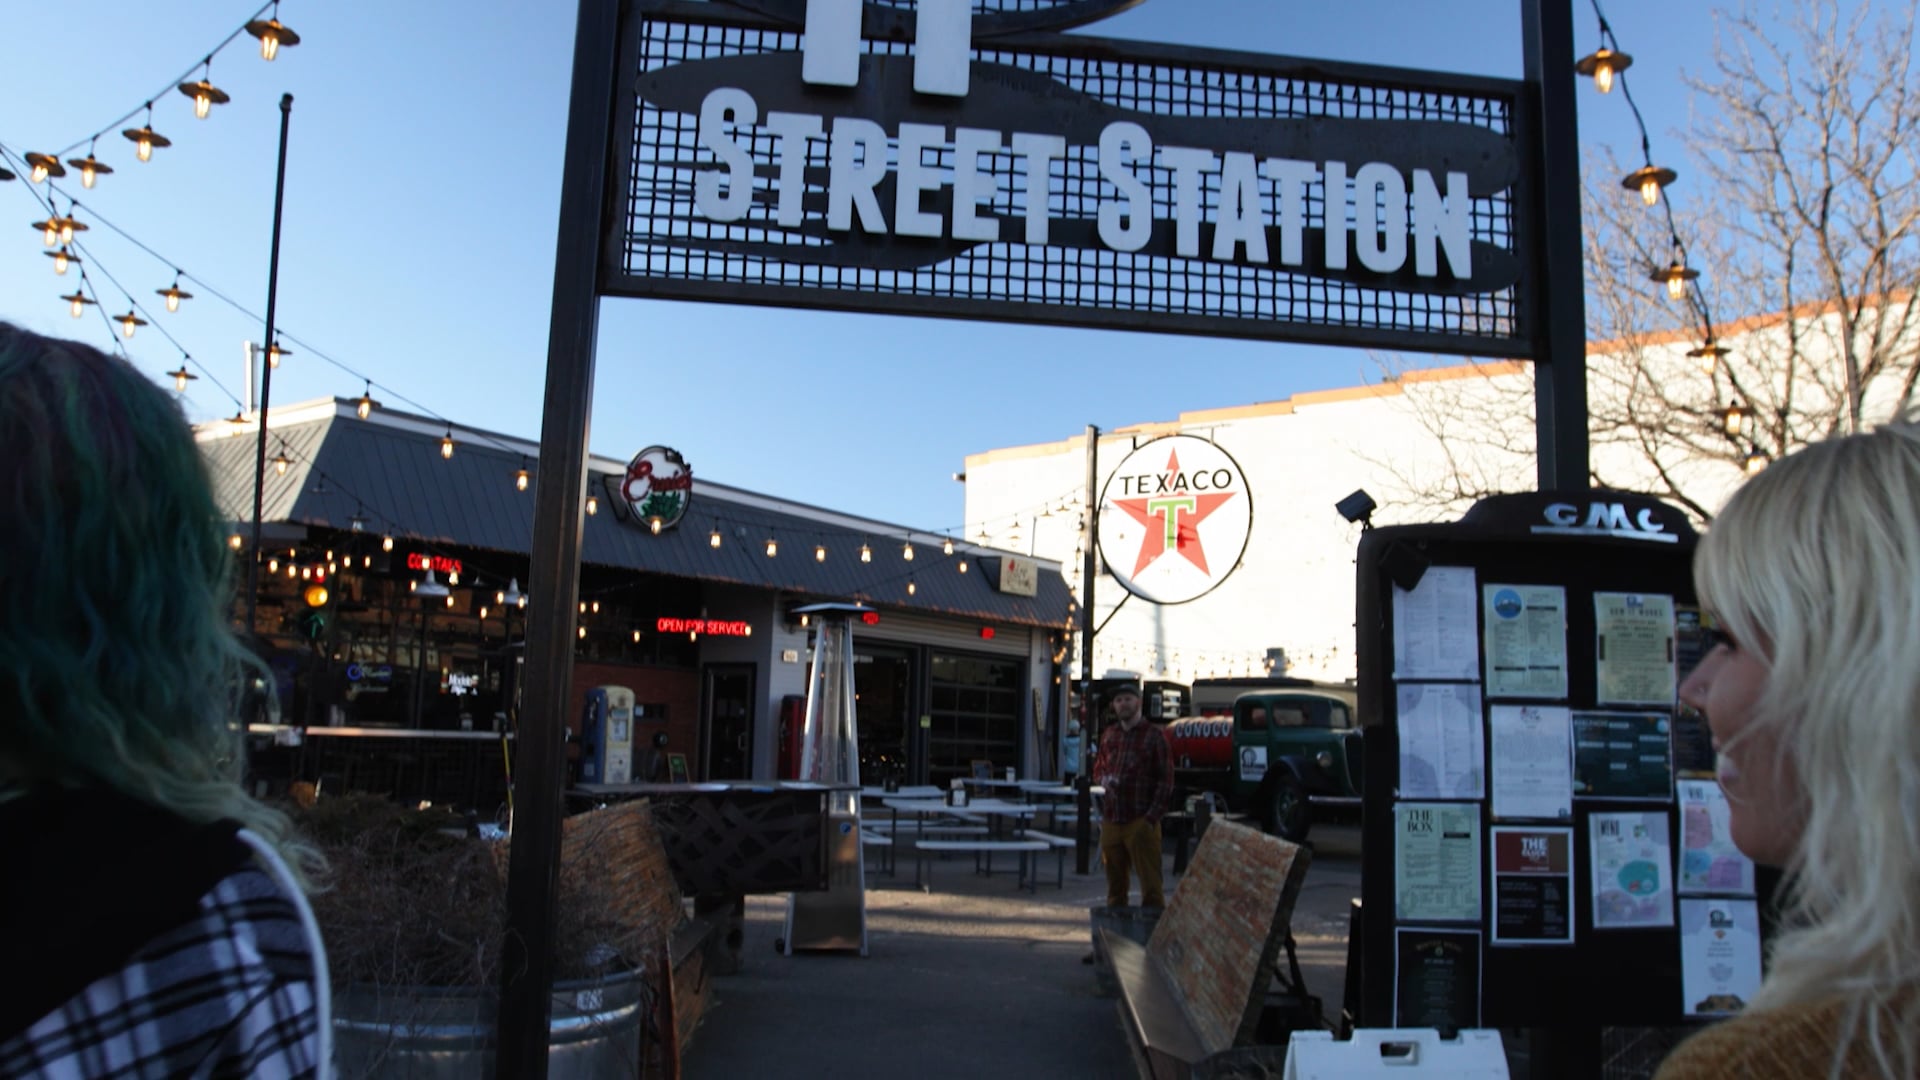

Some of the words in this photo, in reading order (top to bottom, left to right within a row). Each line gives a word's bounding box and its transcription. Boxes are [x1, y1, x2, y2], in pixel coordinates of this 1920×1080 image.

[694, 87, 1066, 245] STREET
[1096, 121, 1473, 280] STATION
[1119, 468, 1232, 496] TEXACO
[1544, 501, 1665, 533] GMC
[657, 617, 684, 633] OPEN
[685, 618, 705, 634] FOR
[706, 620, 747, 636] SERVICE
[1175, 720, 1232, 739] CONOCO
[1407, 809, 1433, 821] THE
[1407, 821, 1433, 833] BOX
[1520, 837, 1548, 850] THE
